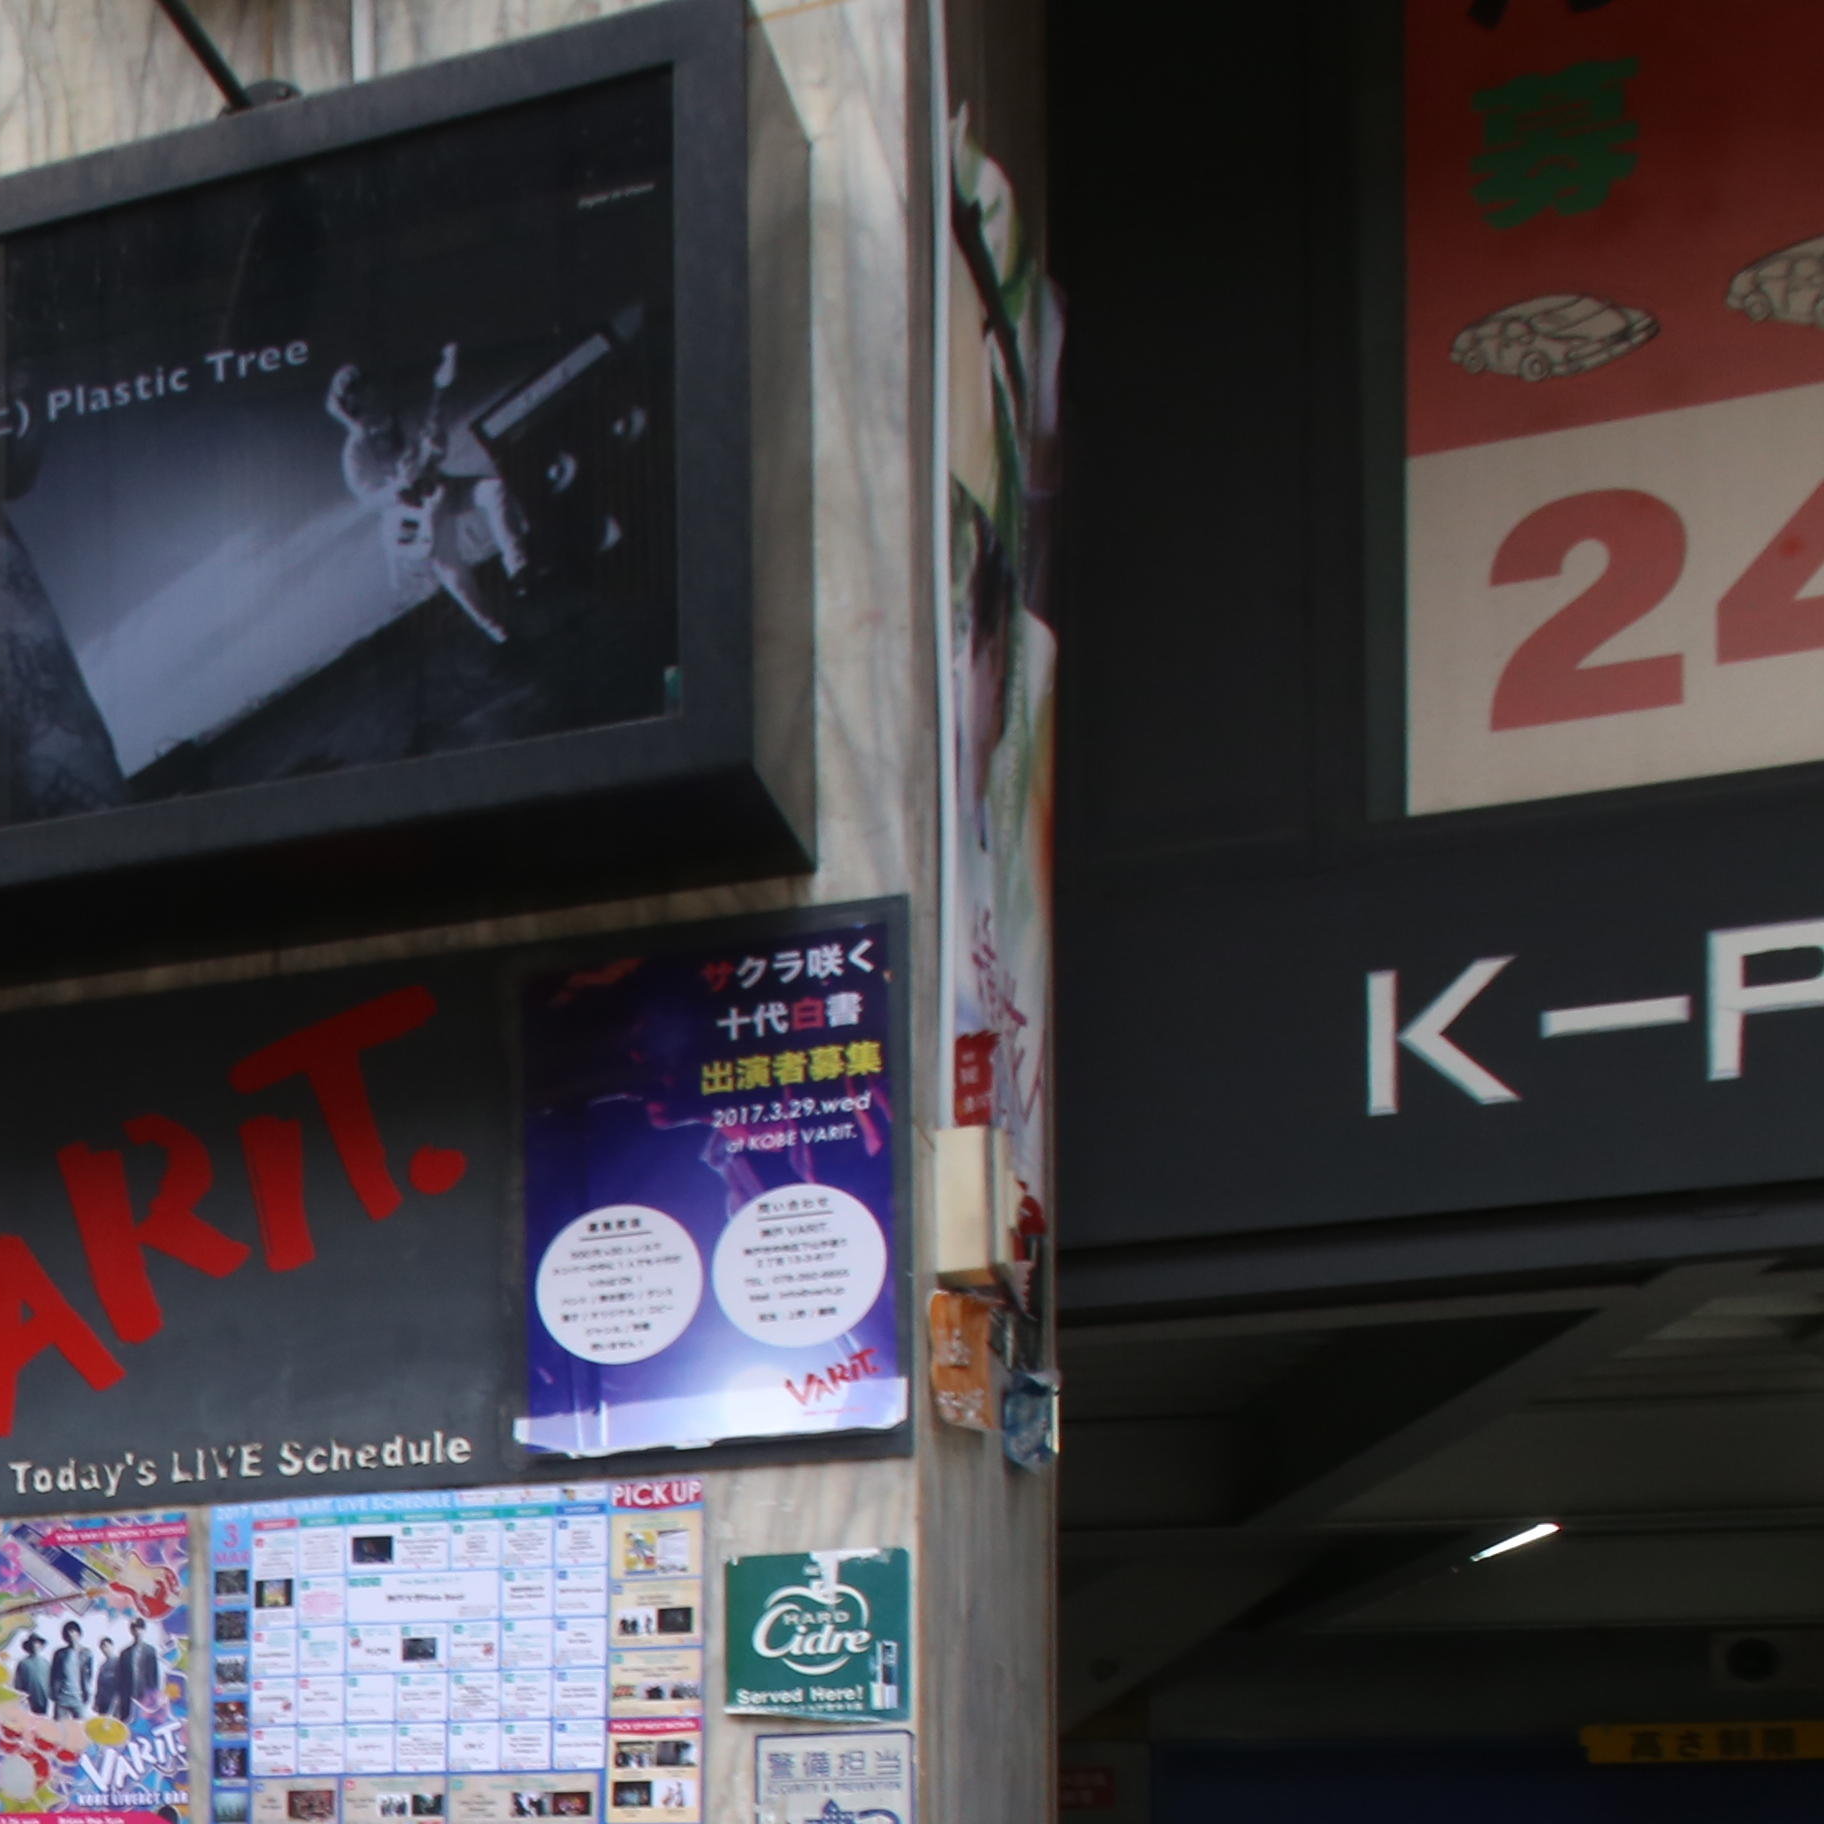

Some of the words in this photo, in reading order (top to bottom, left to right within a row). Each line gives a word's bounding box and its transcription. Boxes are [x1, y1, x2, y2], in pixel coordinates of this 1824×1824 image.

[46, 363, 190, 423] Plastic
[204, 337, 310, 385] Tree
[700, 937, 876, 993] サクラ咲く
[715, 990, 866, 1043] 十代白書
[698, 1042, 886, 1096] 出演者募集
[711, 1091, 874, 1131] 2017.3.29.wed
[8, 1452, 159, 1496] Today's
[169, 1443, 264, 1486] LIVE
[276, 1430, 473, 1481] Schedule
[612, 1482, 667, 1509] PICK
[671, 1479, 703, 1504] UP
[223, 1524, 240, 1548] 3
[752, 1596, 871, 1660] Cidre
[784, 1609, 850, 1628] HARD
[735, 1687, 805, 1707] Served
[809, 1683, 864, 1704] Here!
[80, 1721, 187, 1792] VARIT.
[768, 1751, 903, 1779] 警備担当
[767, 1781, 811, 1795] SECURITY
[823, 1780, 901, 1795] PREVENTION
